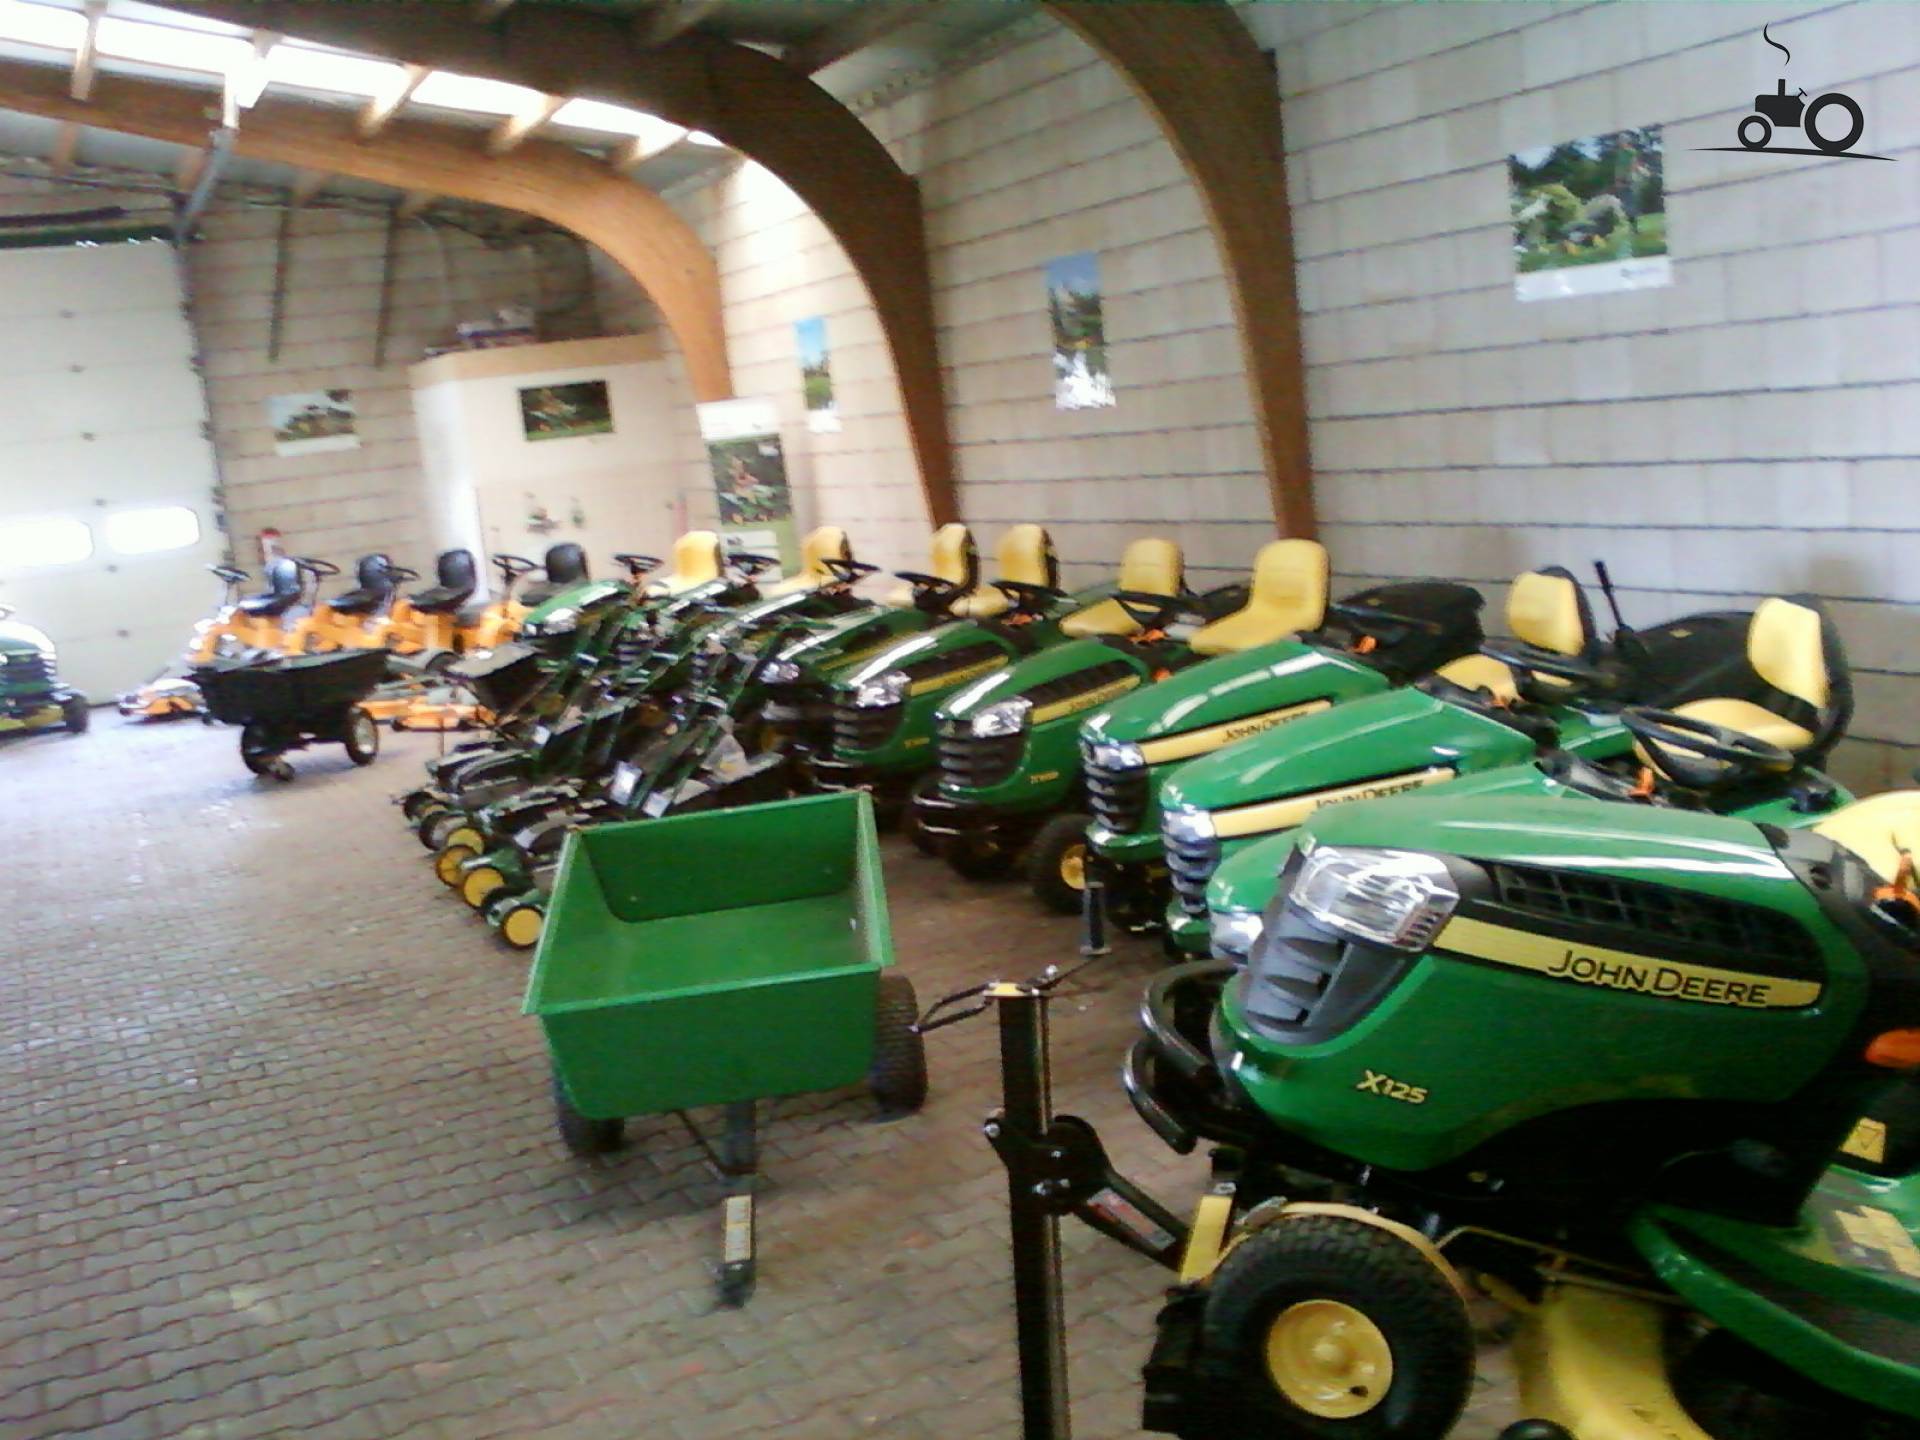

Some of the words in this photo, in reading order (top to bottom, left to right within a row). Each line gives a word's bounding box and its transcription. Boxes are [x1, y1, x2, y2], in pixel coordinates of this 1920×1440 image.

[1548, 949, 1649, 988] JOHN
[1653, 967, 1772, 1004] DEERE
[1356, 1069, 1429, 1104] X125
